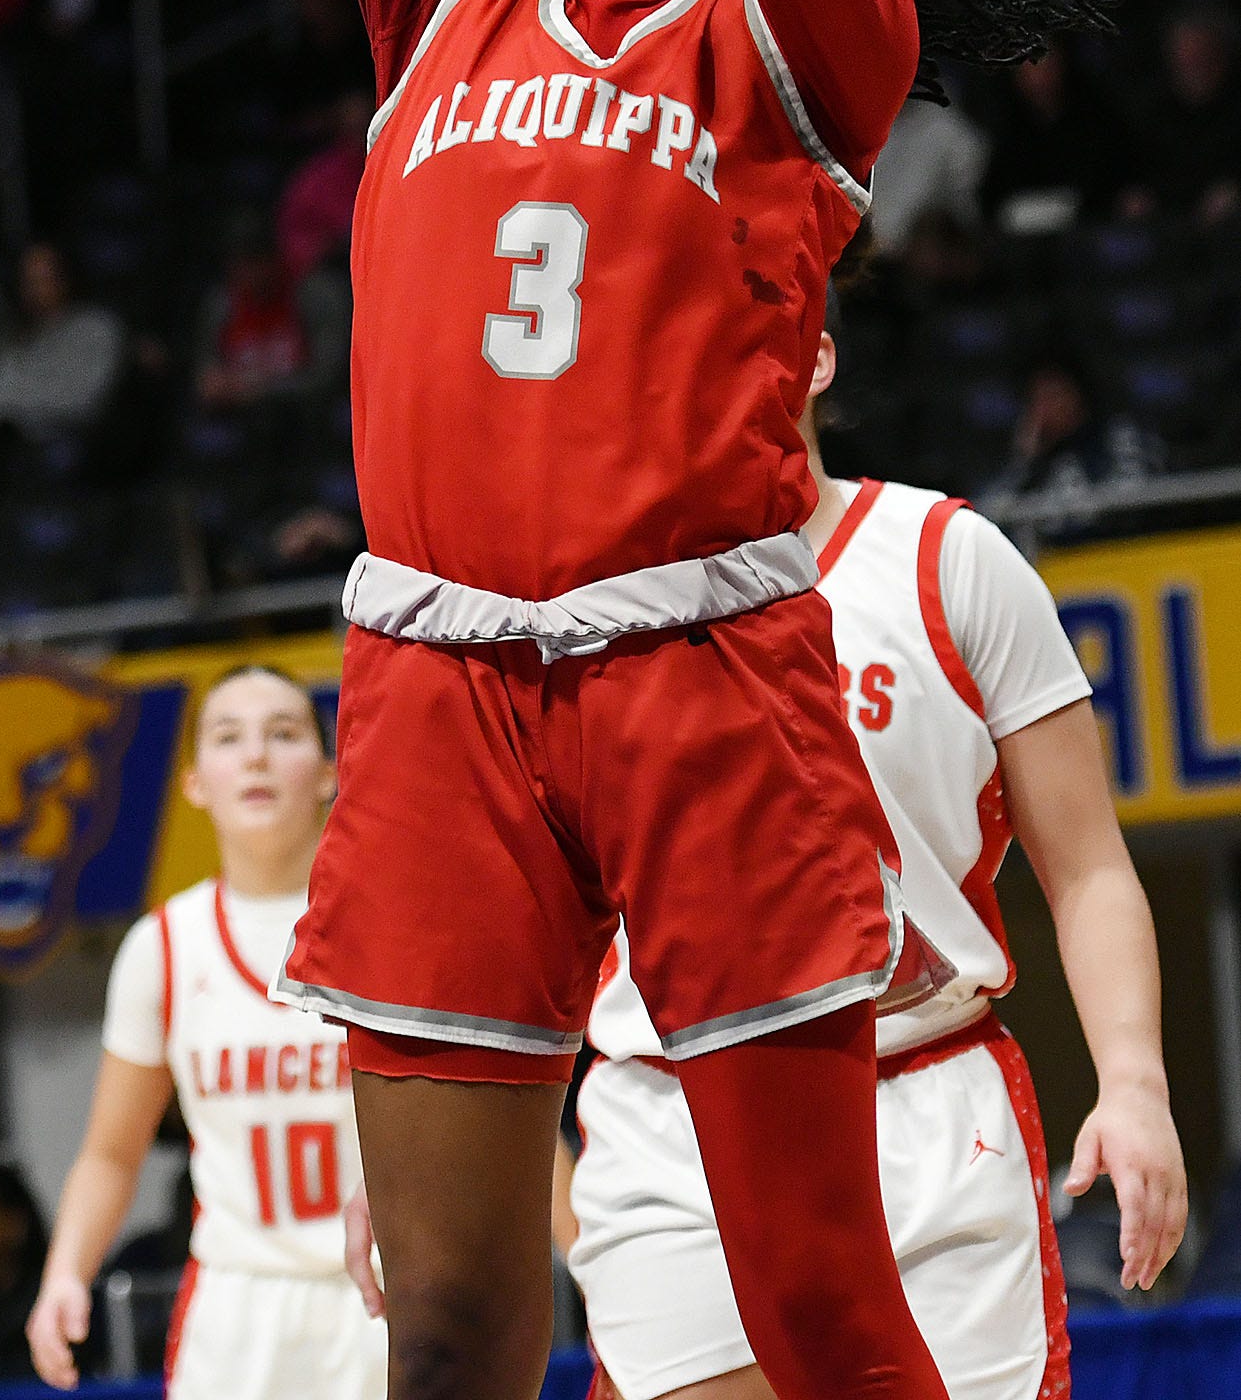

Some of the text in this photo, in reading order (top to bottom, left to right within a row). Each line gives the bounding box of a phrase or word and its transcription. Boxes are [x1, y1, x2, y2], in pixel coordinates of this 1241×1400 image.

[402, 72, 721, 204] ALIQUIPPA
[481, 201, 589, 380] 3
[250, 1121, 340, 1227] 10
